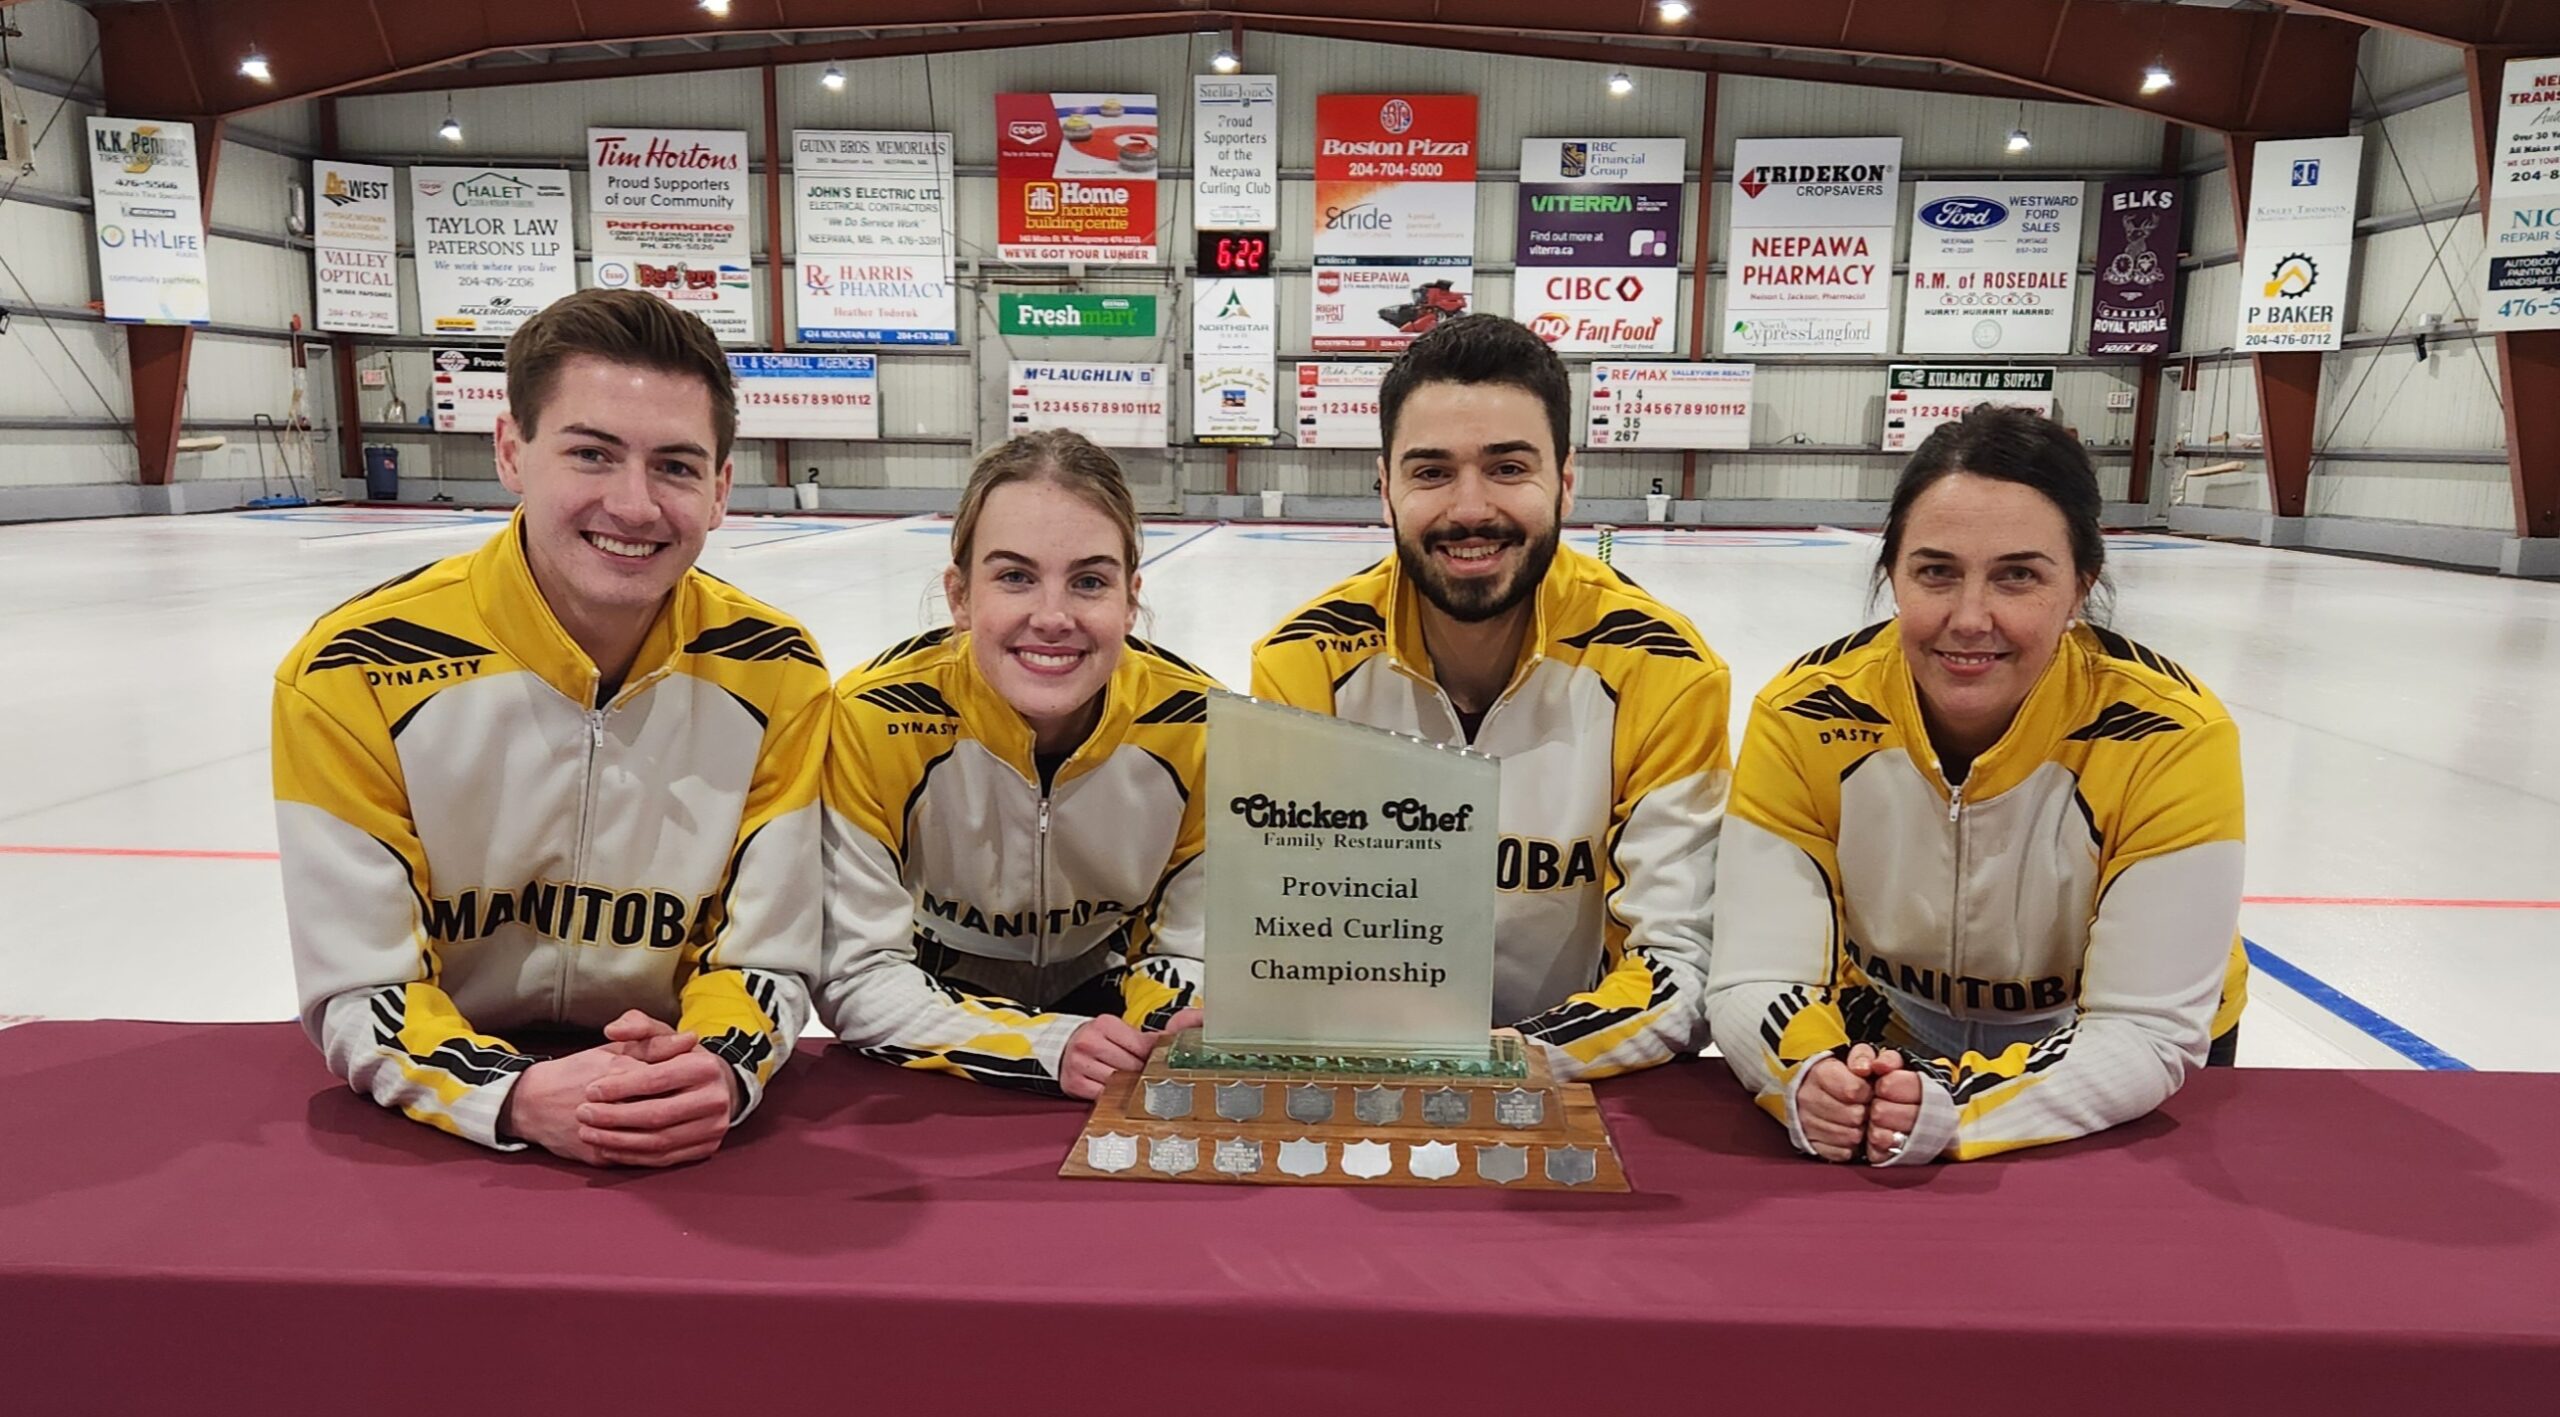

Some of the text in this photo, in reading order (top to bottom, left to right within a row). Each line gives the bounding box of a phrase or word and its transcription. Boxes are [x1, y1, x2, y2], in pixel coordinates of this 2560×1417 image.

[1218, 114, 1253, 128] Proud
[95, 128, 128, 154] K.K.
[1204, 131, 1267, 146] Supporters
[2535, 132, 2548, 140] 30
[595, 136, 739, 170] Tim Hortons
[799, 138, 947, 156] GUINN MEMORIALS
[1218, 148, 1253, 160] of the
[1322, 138, 1470, 156] Boston Pizza
[1591, 141, 1618, 152] RBC
[2524, 145, 2551, 154] Makes
[1591, 152, 1646, 165] Financial
[1210, 165, 1261, 180] Neepawa
[1348, 162, 1443, 177] 204-704-5000
[1590, 165, 1629, 180] Group
[1755, 164, 1886, 183] TRIDEKON
[348, 179, 388, 200] WEST
[608, 175, 730, 192] Proud Supporters
[1199, 181, 1272, 197] Curling Club
[1796, 184, 1884, 197] CROPSAVERS
[453, 182, 523, 207] CHALET
[807, 186, 914, 200] JOHN'S ELECTRIC
[1060, 182, 1130, 205] Home
[2008, 195, 2079, 207] WESTWARD
[2112, 190, 2174, 212] ELKS
[604, 193, 735, 210] of our Community
[809, 201, 939, 213] ELECTRICAL CONTRACTORS
[1531, 195, 1633, 212] VITERRA
[1060, 204, 1129, 218] hardware
[1325, 205, 1393, 231] Stride
[1934, 202, 1992, 225] Ford
[2025, 209, 2060, 220] FORD
[426, 217, 558, 235] TAYLOR LAW
[606, 220, 735, 232] Performance
[845, 217, 894, 228] Do Service
[1025, 216, 1129, 232] building centre
[2021, 222, 2061, 233] SALES
[1529, 231, 1604, 242] Find out more at
[2500, 230, 2550, 243] REPAIR
[427, 240, 560, 256] PATERSONS LLP
[1004, 248, 1149, 261] WE'VE GOT YOUR LUMBER
[1528, 244, 1574, 256] viterra.ca
[1752, 236, 1869, 257] NEEPAWA
[325, 250, 388, 269] VALLEY
[434, 260, 557, 273] We work where you live
[2503, 257, 2560, 269] AUTOBODY
[320, 267, 393, 287] OPTICAL
[840, 265, 914, 281] HARRIS
[1343, 271, 1411, 283] NEEPAWA
[1743, 264, 1875, 285] PHARMACY
[2507, 266, 2554, 277] PAINTING
[1915, 271, 2069, 289] R.M. of ROSEDALE
[839, 281, 945, 298] PHARMACY
[1546, 277, 1612, 301] CIBC
[834, 307, 873, 318] Heather
[2102, 308, 2156, 318] CANADA
[2248, 305, 2334, 323] P BAKER
[1198, 323, 1270, 332] NORTHSTAR
[2093, 318, 2169, 333] ROYAL PURPLE
[2245, 333, 2332, 346] 204-476-0712
[817, 358, 871, 370] AGENCIES
[1024, 368, 1134, 382] McLAUGHLIN
[1611, 369, 1668, 381] RE/MAX
[1927, 371, 2045, 388] KULBACKI AG SUPPLY
[2111, 393, 2130, 406] EXIT
[808, 467, 820, 483] 2
[1651, 478, 1663, 495] 5
[1315, 634, 1387, 653] DYNAST
[366, 659, 481, 686] DYNASTY
[1230, 793, 1474, 832] Chicken Chef
[1263, 832, 1442, 851] Family Restaurants
[1281, 876, 1419, 899] Provincial
[1254, 917, 1445, 945] Mixed Curling
[1250, 959, 1447, 987] Championship
